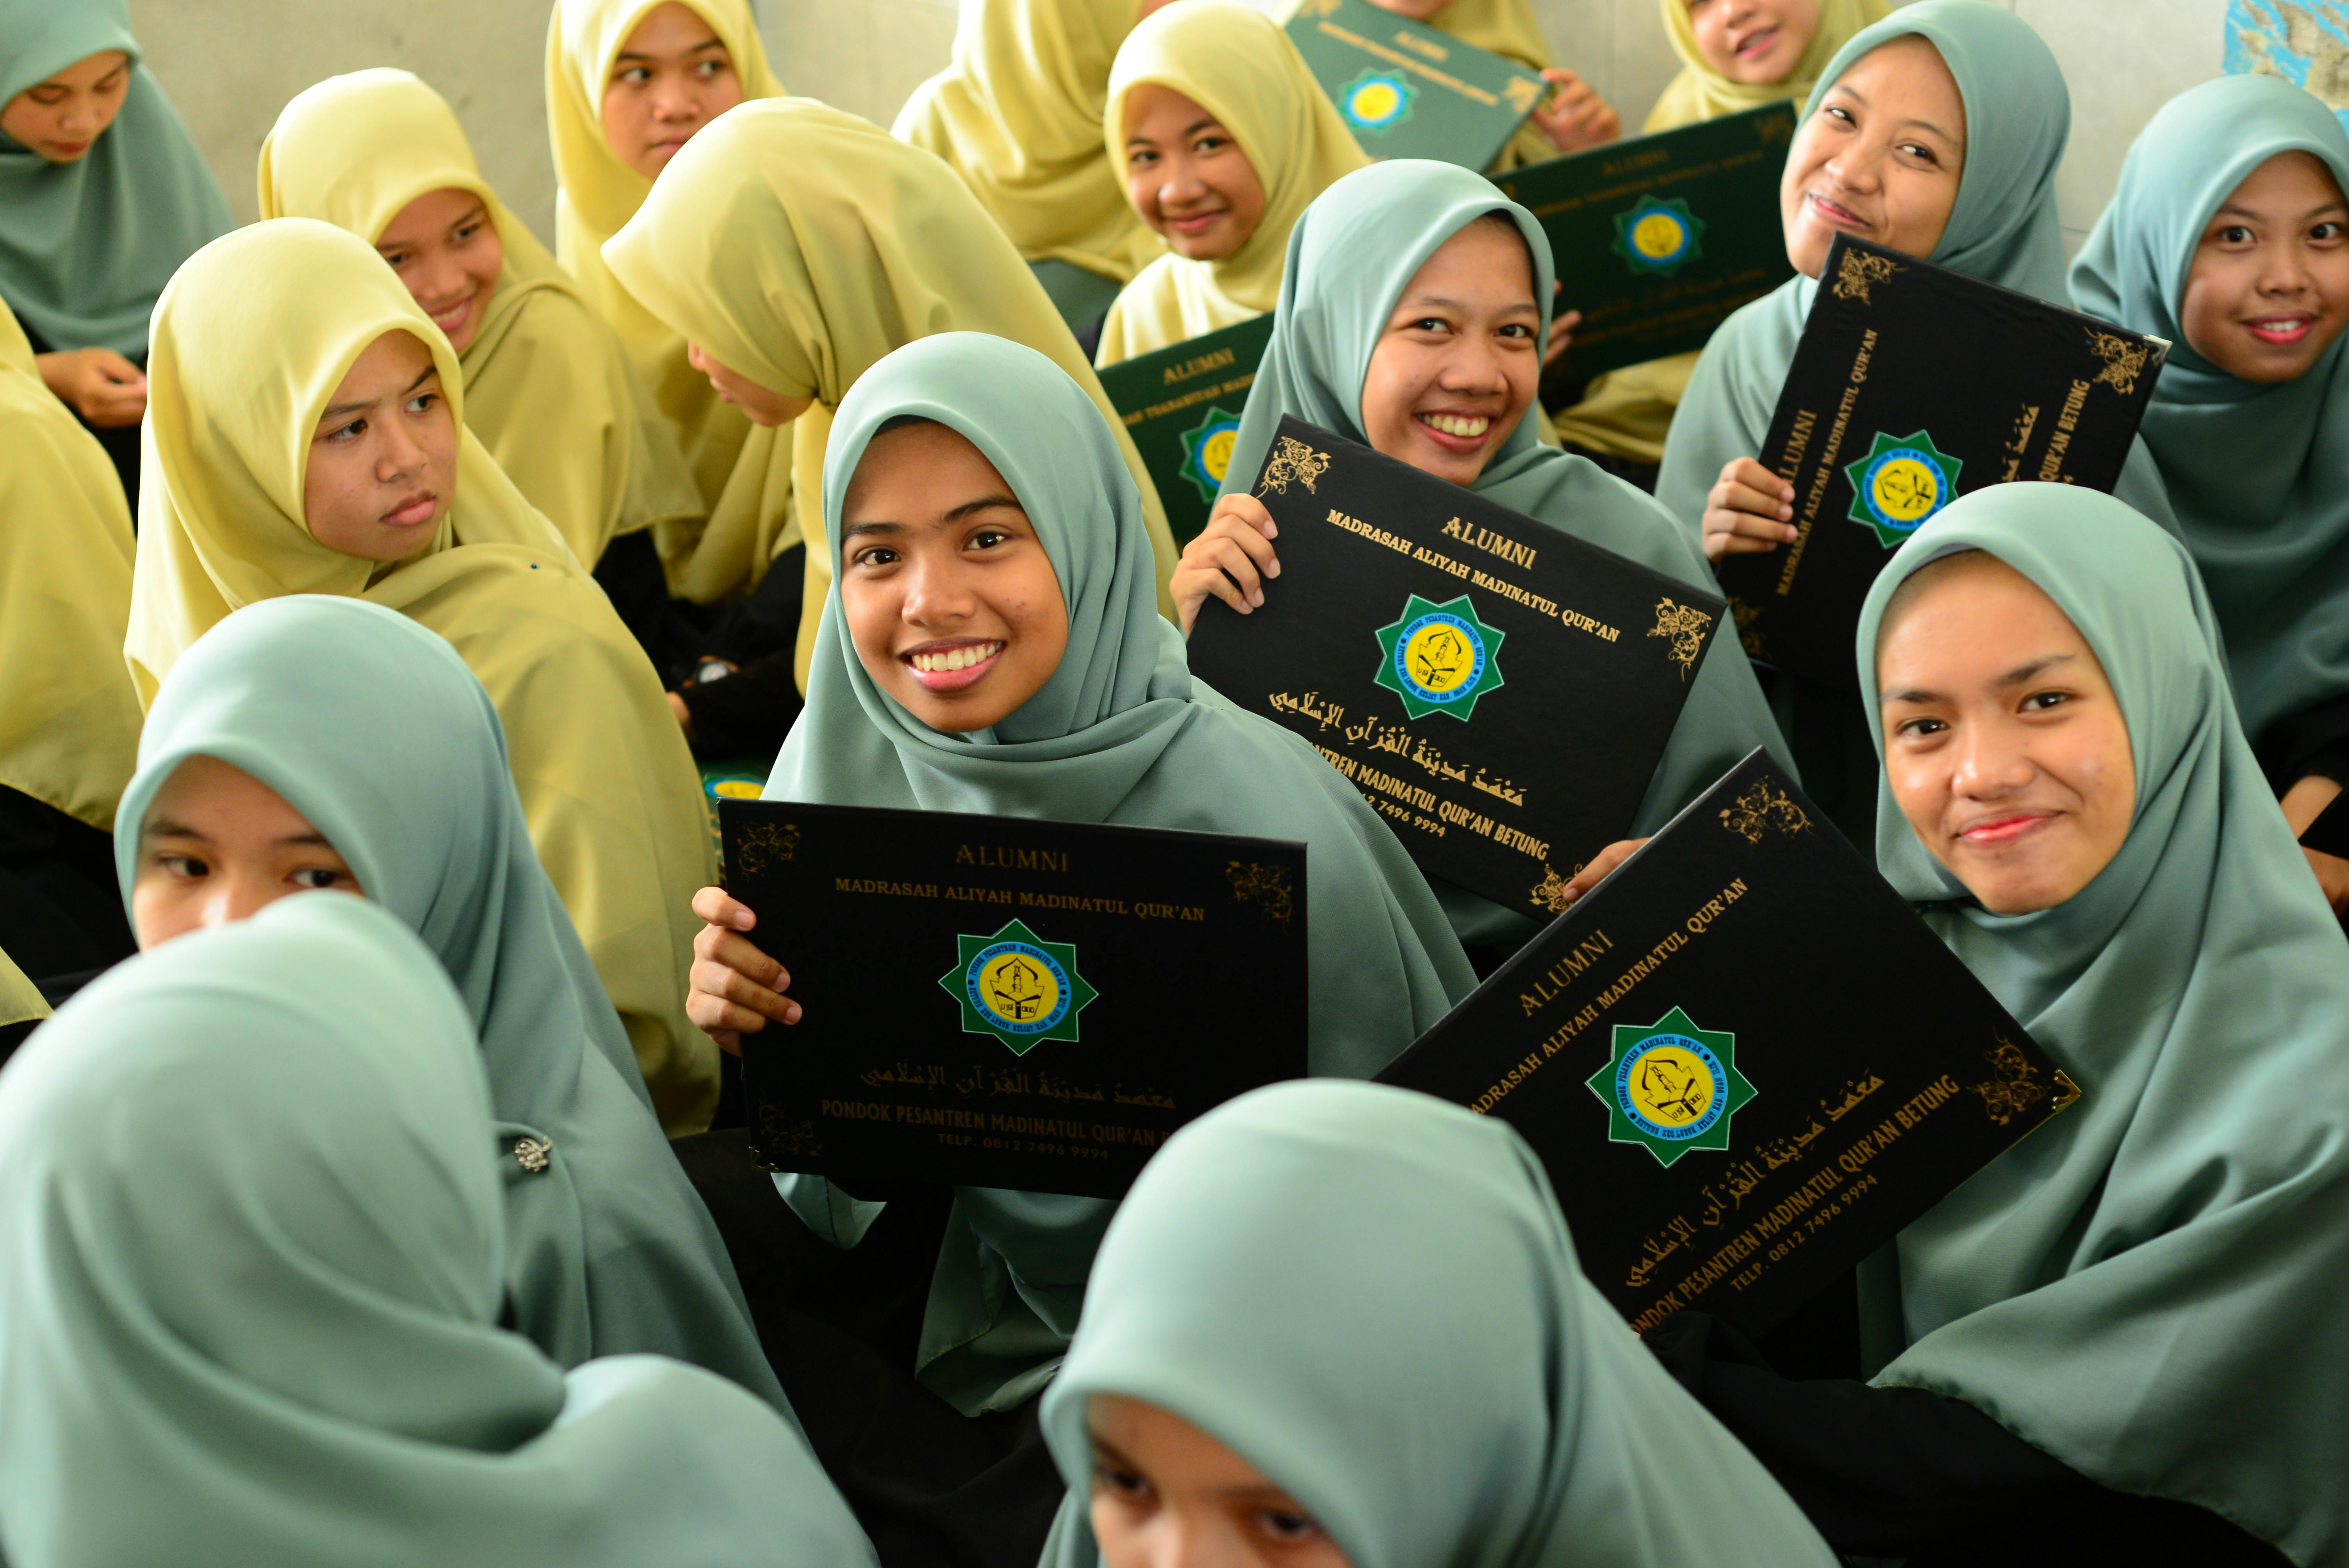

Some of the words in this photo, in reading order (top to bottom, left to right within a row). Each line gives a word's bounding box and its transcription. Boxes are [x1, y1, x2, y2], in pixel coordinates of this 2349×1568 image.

[1163, 347, 1235, 386] ALUMNI
[2058, 379, 2091, 432] BETUNG
[1777, 519, 1812, 595] MADRASAH
[1804, 467, 1830, 519] ALIYAH
[1821, 386, 1859, 466] MADINATUL
[1850, 329, 1878, 383] QUR'AN
[1778, 409, 1817, 484] LUMNI
[1441, 517, 1537, 569] ALUMNI
[1327, 510, 1413, 554] MADRASAH
[1413, 547, 1470, 579] ALIYAH
[1471, 570, 1558, 617] MADINATUL
[1562, 609, 1620, 642] QUR'AN
[1357, 765, 1436, 812] MADINATUL
[1438, 801, 1495, 837] QUR'AN
[1494, 824, 1550, 861] BETUNG
[1378, 800, 1410, 822] 7496
[1414, 816, 1446, 837] 9994
[956, 844, 1067, 872] ALUMNI
[835, 878, 938, 898] MADRASAH
[946, 887, 1012, 904] ALIYAH
[1019, 892, 1128, 914] MADINATUL
[1134, 902, 1205, 921] QUR'AN
[1470, 1051, 1543, 1114] ADRASAH
[1542, 1004, 1599, 1058] ALIYAH
[1596, 932, 1689, 1009] MADINATUL
[1687, 878, 1748, 933] QUR'AN
[1520, 930, 1614, 1017] ALUMNI
[1618, 1049, 1639, 1082] PESANTREN
[1640, 1037, 1675, 1051] MADINATUL
[822, 1099, 891, 1121] PONDOK
[896, 1106, 985, 1129] PESANTREN
[991, 1114, 1086, 1139] MADINATUL
[1092, 1124, 1155, 1147] QUR'AN
[937, 1133, 977, 1147] TELP.
[983, 1137, 1020, 1151] 0812
[1028, 1140, 1065, 1155] 7496
[1071, 1146, 1108, 1160] 9994
[1677, 1230, 1761, 1300] PESANTREN
[1754, 1166, 1843, 1239] MADINATUL
[1838, 1120, 1901, 1172] QUR'AN
[1895, 1074, 1960, 1129] BETUNG
[1731, 1262, 1769, 1291] TELP.
[1769, 1231, 1805, 1262] 0812
[1805, 1203, 1841, 1233] 7496
[1841, 1174, 1877, 1205] 9994
